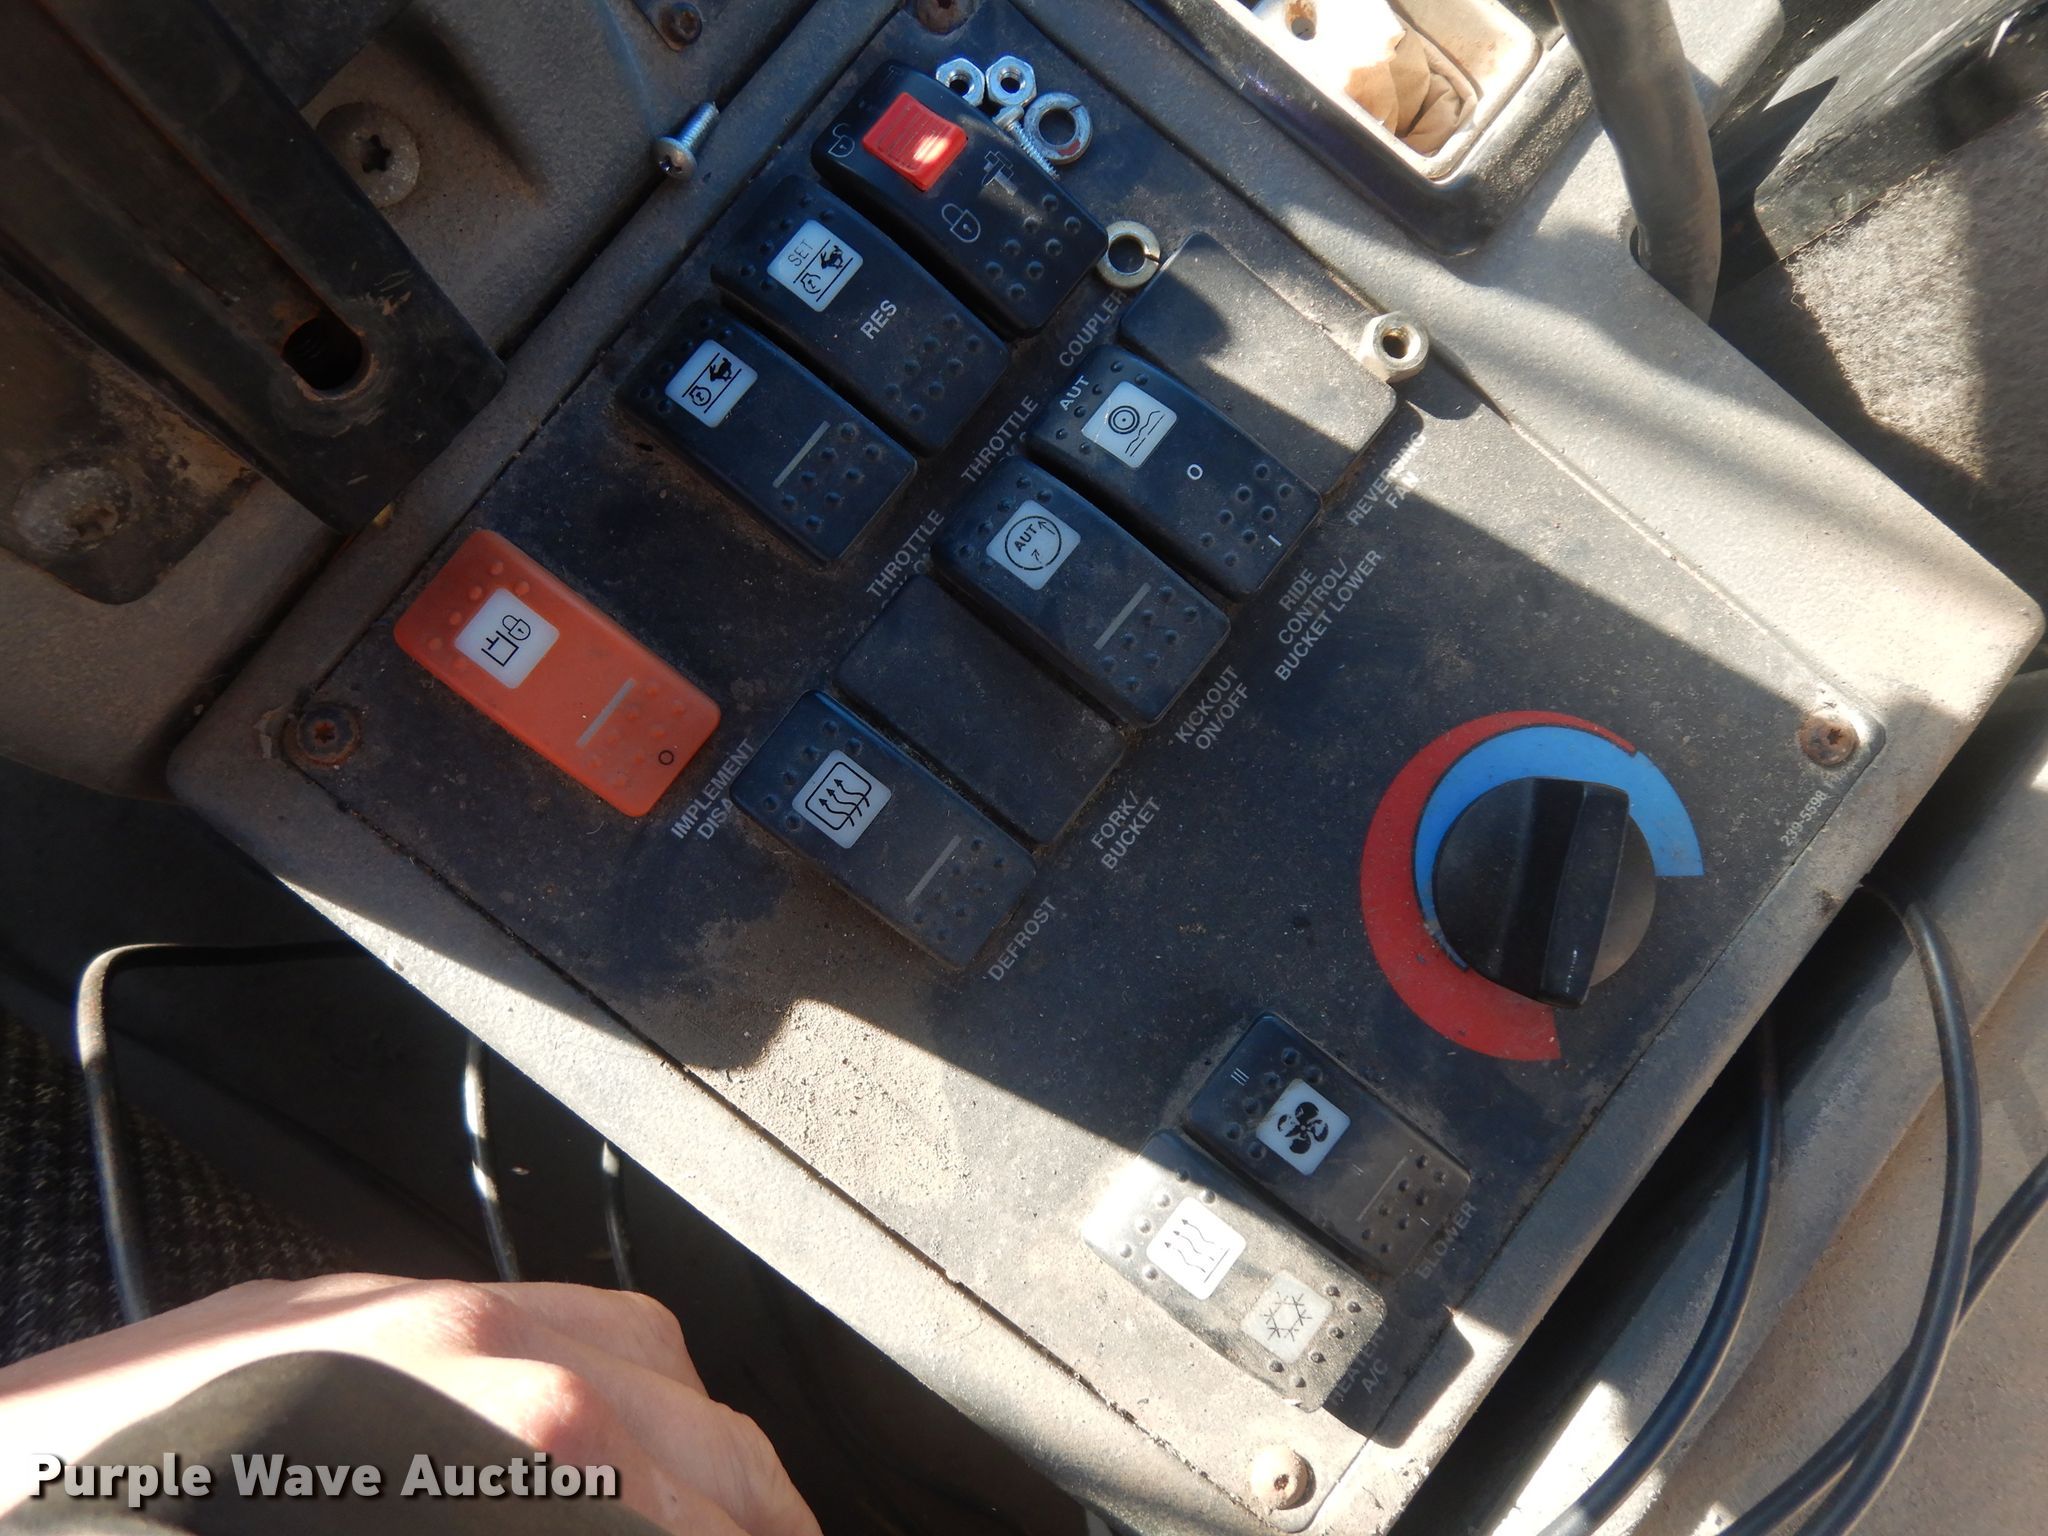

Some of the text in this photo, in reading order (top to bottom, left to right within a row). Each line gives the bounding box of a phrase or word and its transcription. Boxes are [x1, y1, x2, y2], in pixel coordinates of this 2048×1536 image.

[787, 239, 814, 267] SET
[860, 299, 898, 340] RES
[1059, 288, 1128, 367] COUPLER
[1060, 375, 1089, 411] AUT
[960, 395, 1039, 483] THROTTLE
[1346, 431, 1427, 526] REVERSING
[1385, 471, 1420, 509] FAN
[866, 509, 945, 597] THROTTLE
[1014, 523, 1038, 552] AUT
[1274, 549, 1386, 682] BUCKET LOWER
[1278, 567, 1317, 613] RIDE
[1278, 558, 1349, 646] CONTROL/
[1174, 664, 1240, 745] KICKOUT
[1194, 684, 1251, 751] ON/OFF
[671, 738, 755, 839] IMPLEMENT
[696, 798, 735, 840] DISA
[1091, 789, 1139, 850] FORK/
[1780, 789, 1830, 847] 239-5598
[1101, 796, 1160, 870] BUCKET
[987, 896, 1058, 983] DEFROST
[1416, 1201, 1478, 1280] BLOWER
[1362, 1358, 1389, 1395] A/C
